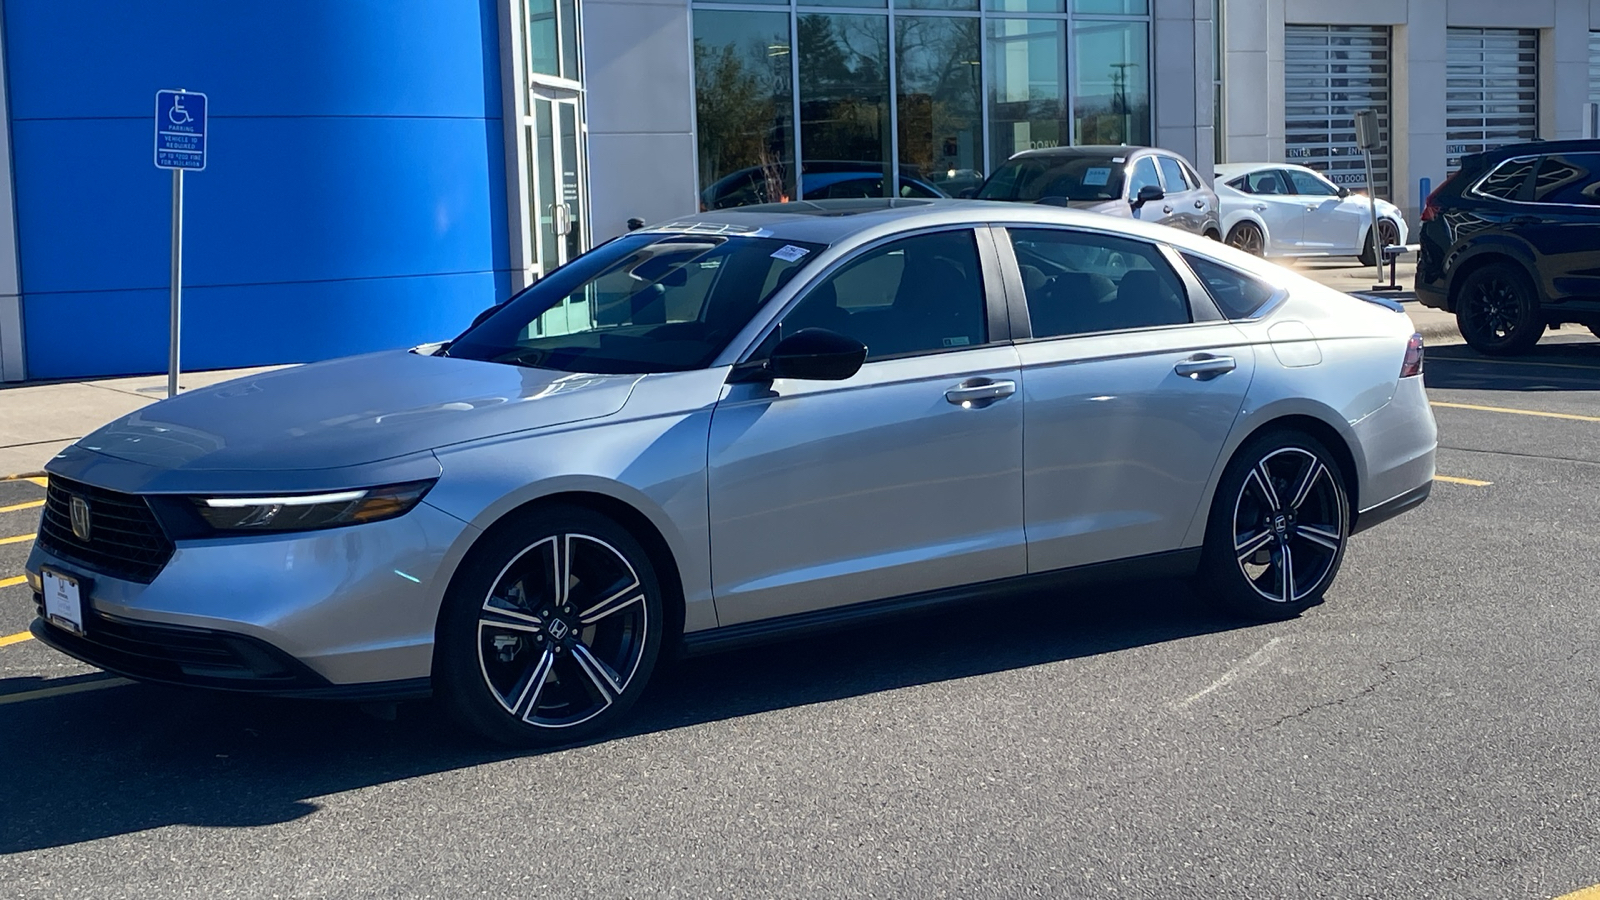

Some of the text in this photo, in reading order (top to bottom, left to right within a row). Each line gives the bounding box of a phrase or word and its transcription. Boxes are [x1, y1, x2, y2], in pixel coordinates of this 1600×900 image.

[1289, 148, 1311, 157] ENTER
[1334, 174, 1365, 183] TO DOOR
